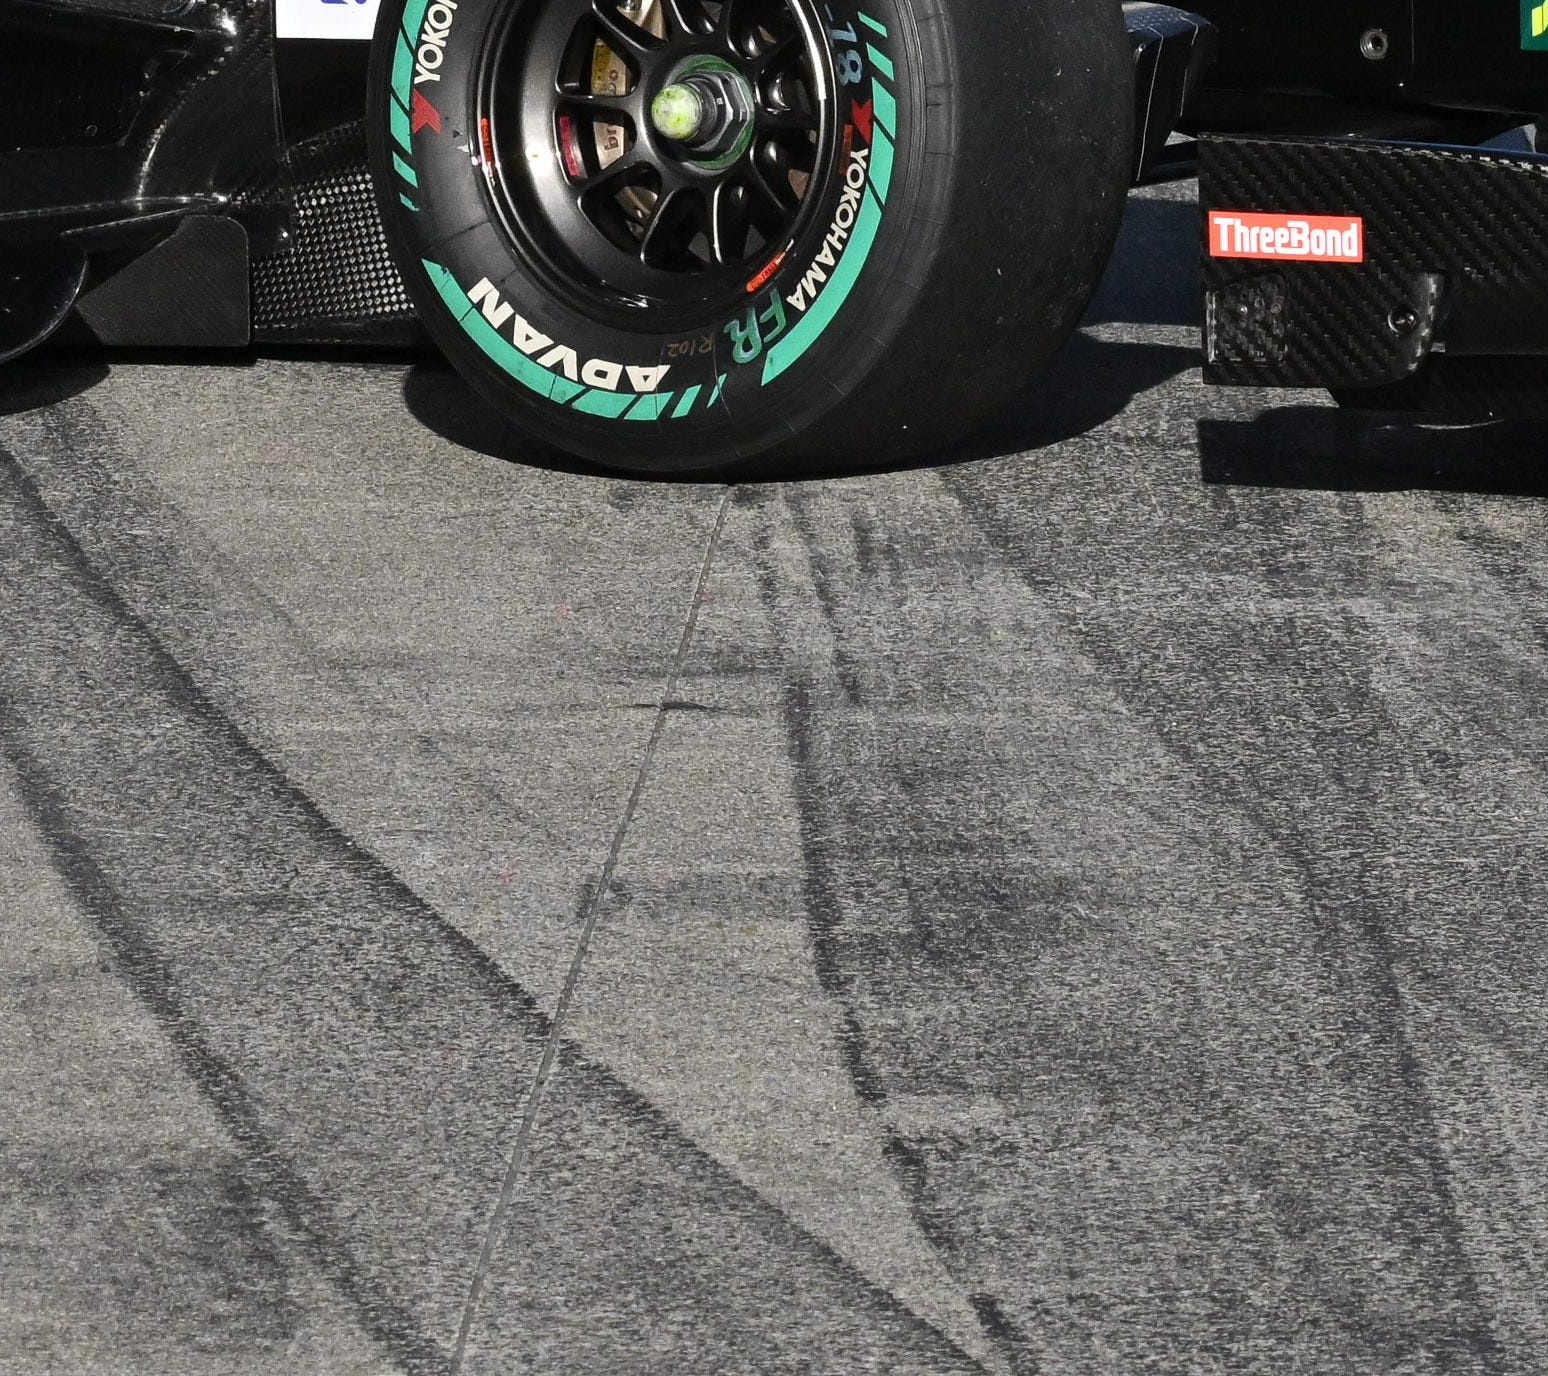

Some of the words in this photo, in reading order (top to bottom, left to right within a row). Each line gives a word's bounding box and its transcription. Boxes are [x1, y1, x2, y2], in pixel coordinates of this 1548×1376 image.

[786, 146, 869, 313] YOKOHAMA
[1212, 217, 1360, 258] ThreeBond
[467, 275, 671, 393] ADVAN
[724, 289, 788, 365] FR
